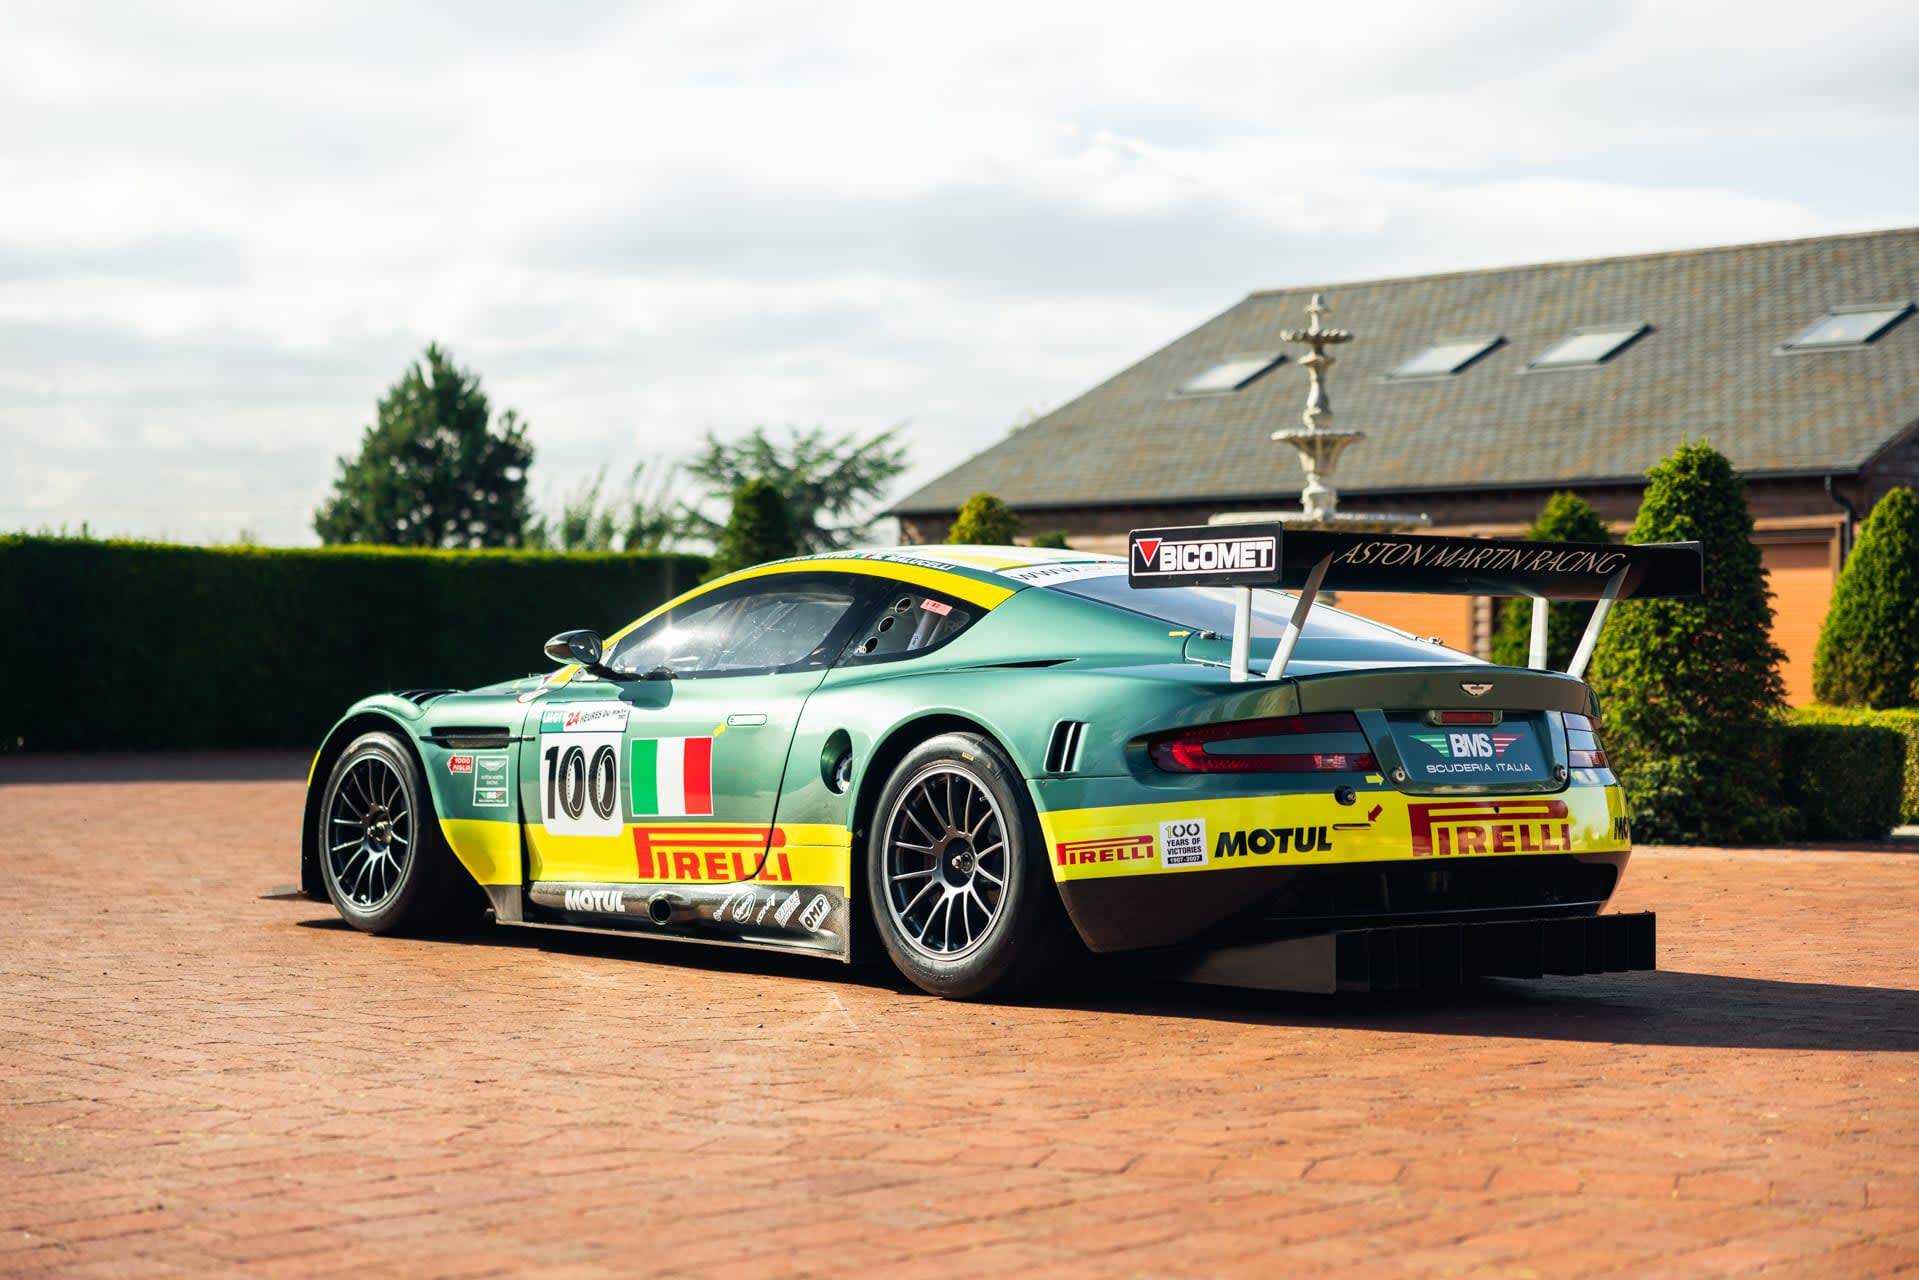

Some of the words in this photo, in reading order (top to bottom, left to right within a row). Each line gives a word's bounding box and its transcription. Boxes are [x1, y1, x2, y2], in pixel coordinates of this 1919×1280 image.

[1159, 540, 1273, 572] BICOMET
[1333, 541, 1436, 566] ASTON
[1425, 545, 1534, 570] MARTIN
[1524, 550, 1626, 574] RACING
[565, 711, 580, 727] 24
[1449, 733, 1493, 758] BMS
[544, 744, 616, 820] 100
[1426, 763, 1493, 774] SCUDERIA
[1496, 763, 1533, 772] ITALIA
[1165, 823, 1200, 839] 100
[1166, 838, 1189, 847] YEARS
[1192, 837, 1201, 846] OF
[1214, 826, 1333, 858] MOTUL
[1408, 799, 1572, 857] PIRELLI
[633, 827, 793, 882] PIRELLI
[1056, 835, 1154, 866] PIRELLI
[1167, 846, 1202, 855] VICTORIES
[564, 889, 626, 913] MOTUL
[804, 898, 825, 929] OMP
